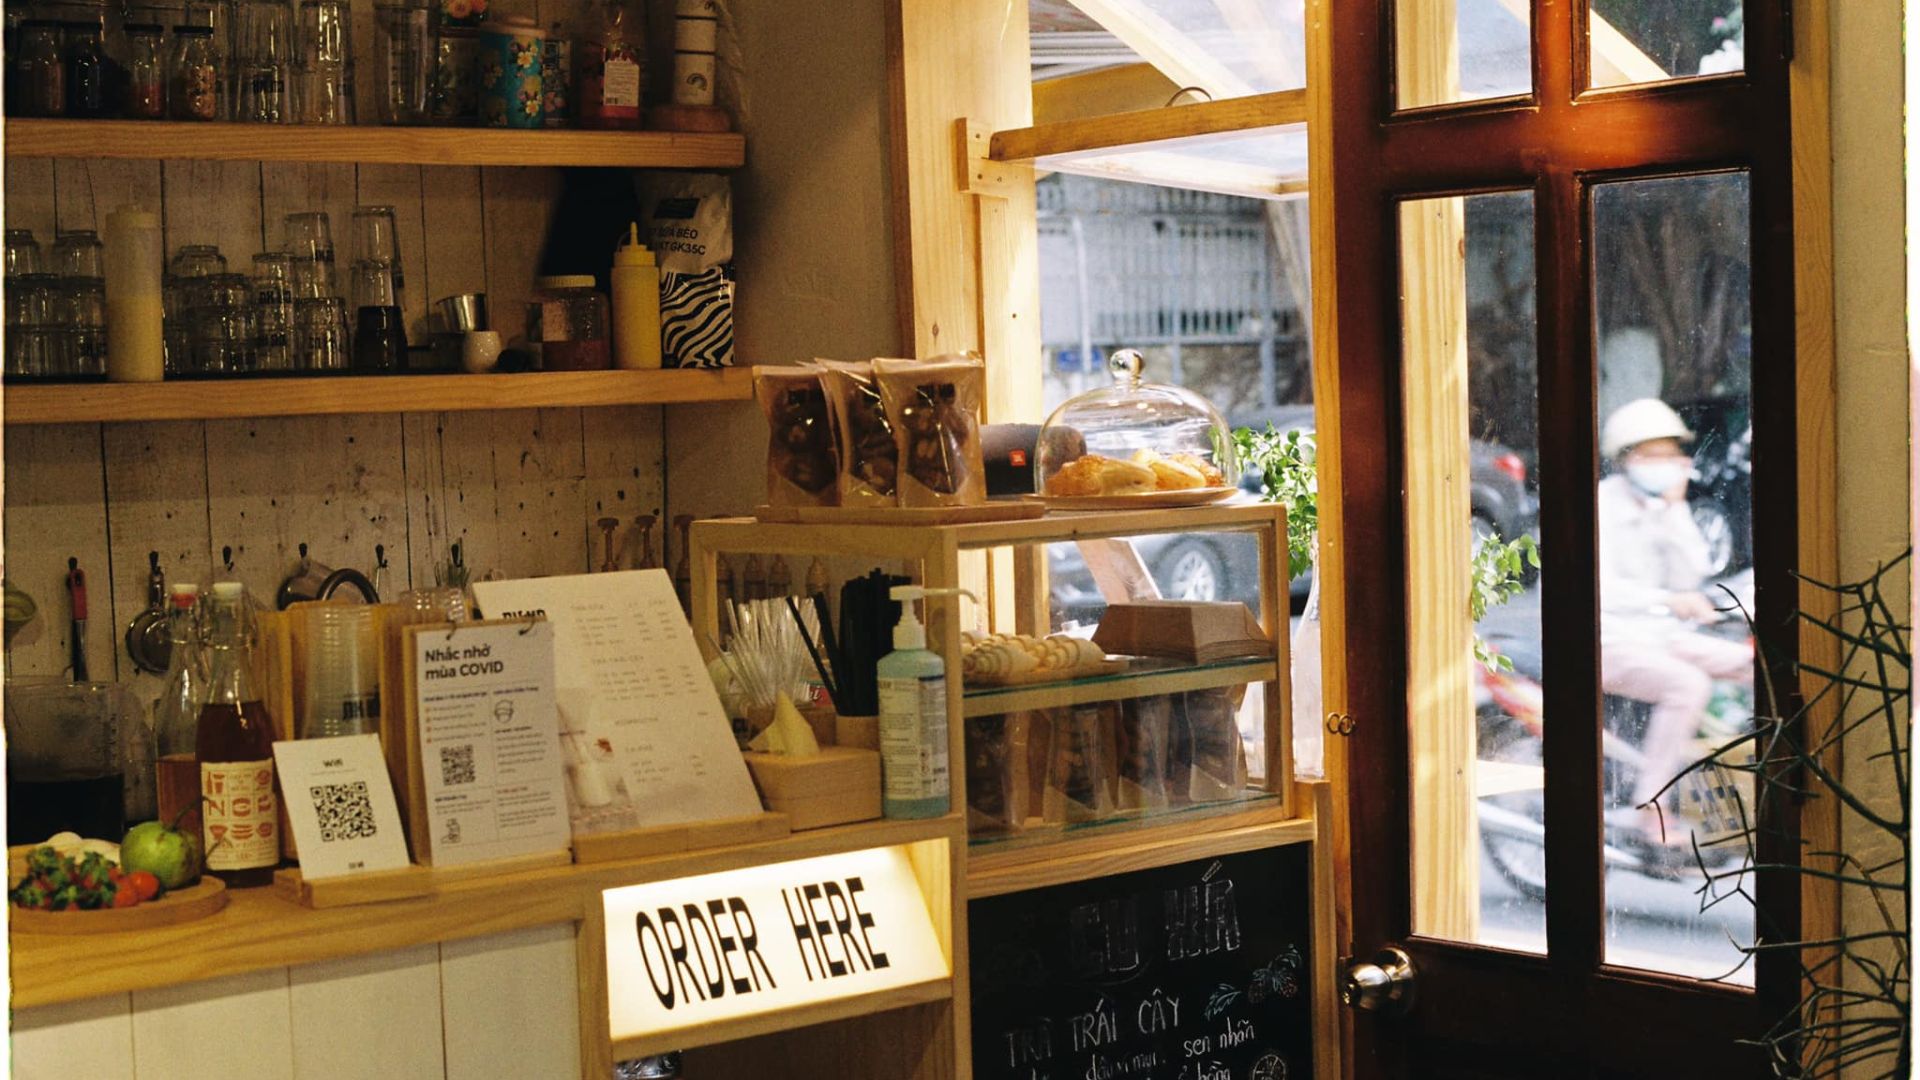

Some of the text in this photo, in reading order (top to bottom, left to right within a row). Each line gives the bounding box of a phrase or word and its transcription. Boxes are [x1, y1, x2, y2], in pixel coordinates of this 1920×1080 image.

[425, 643, 491, 663] Nhắc nhở
[425, 660, 504, 680] mùa COVID
[636, 876, 890, 1010] ORDER HERE
[1070, 998, 1117, 1052] TRÁI
[1138, 988, 1180, 1034] CÂY
[1184, 1035, 1211, 1058] sen
[1219, 1016, 1255, 1049] nhãn
